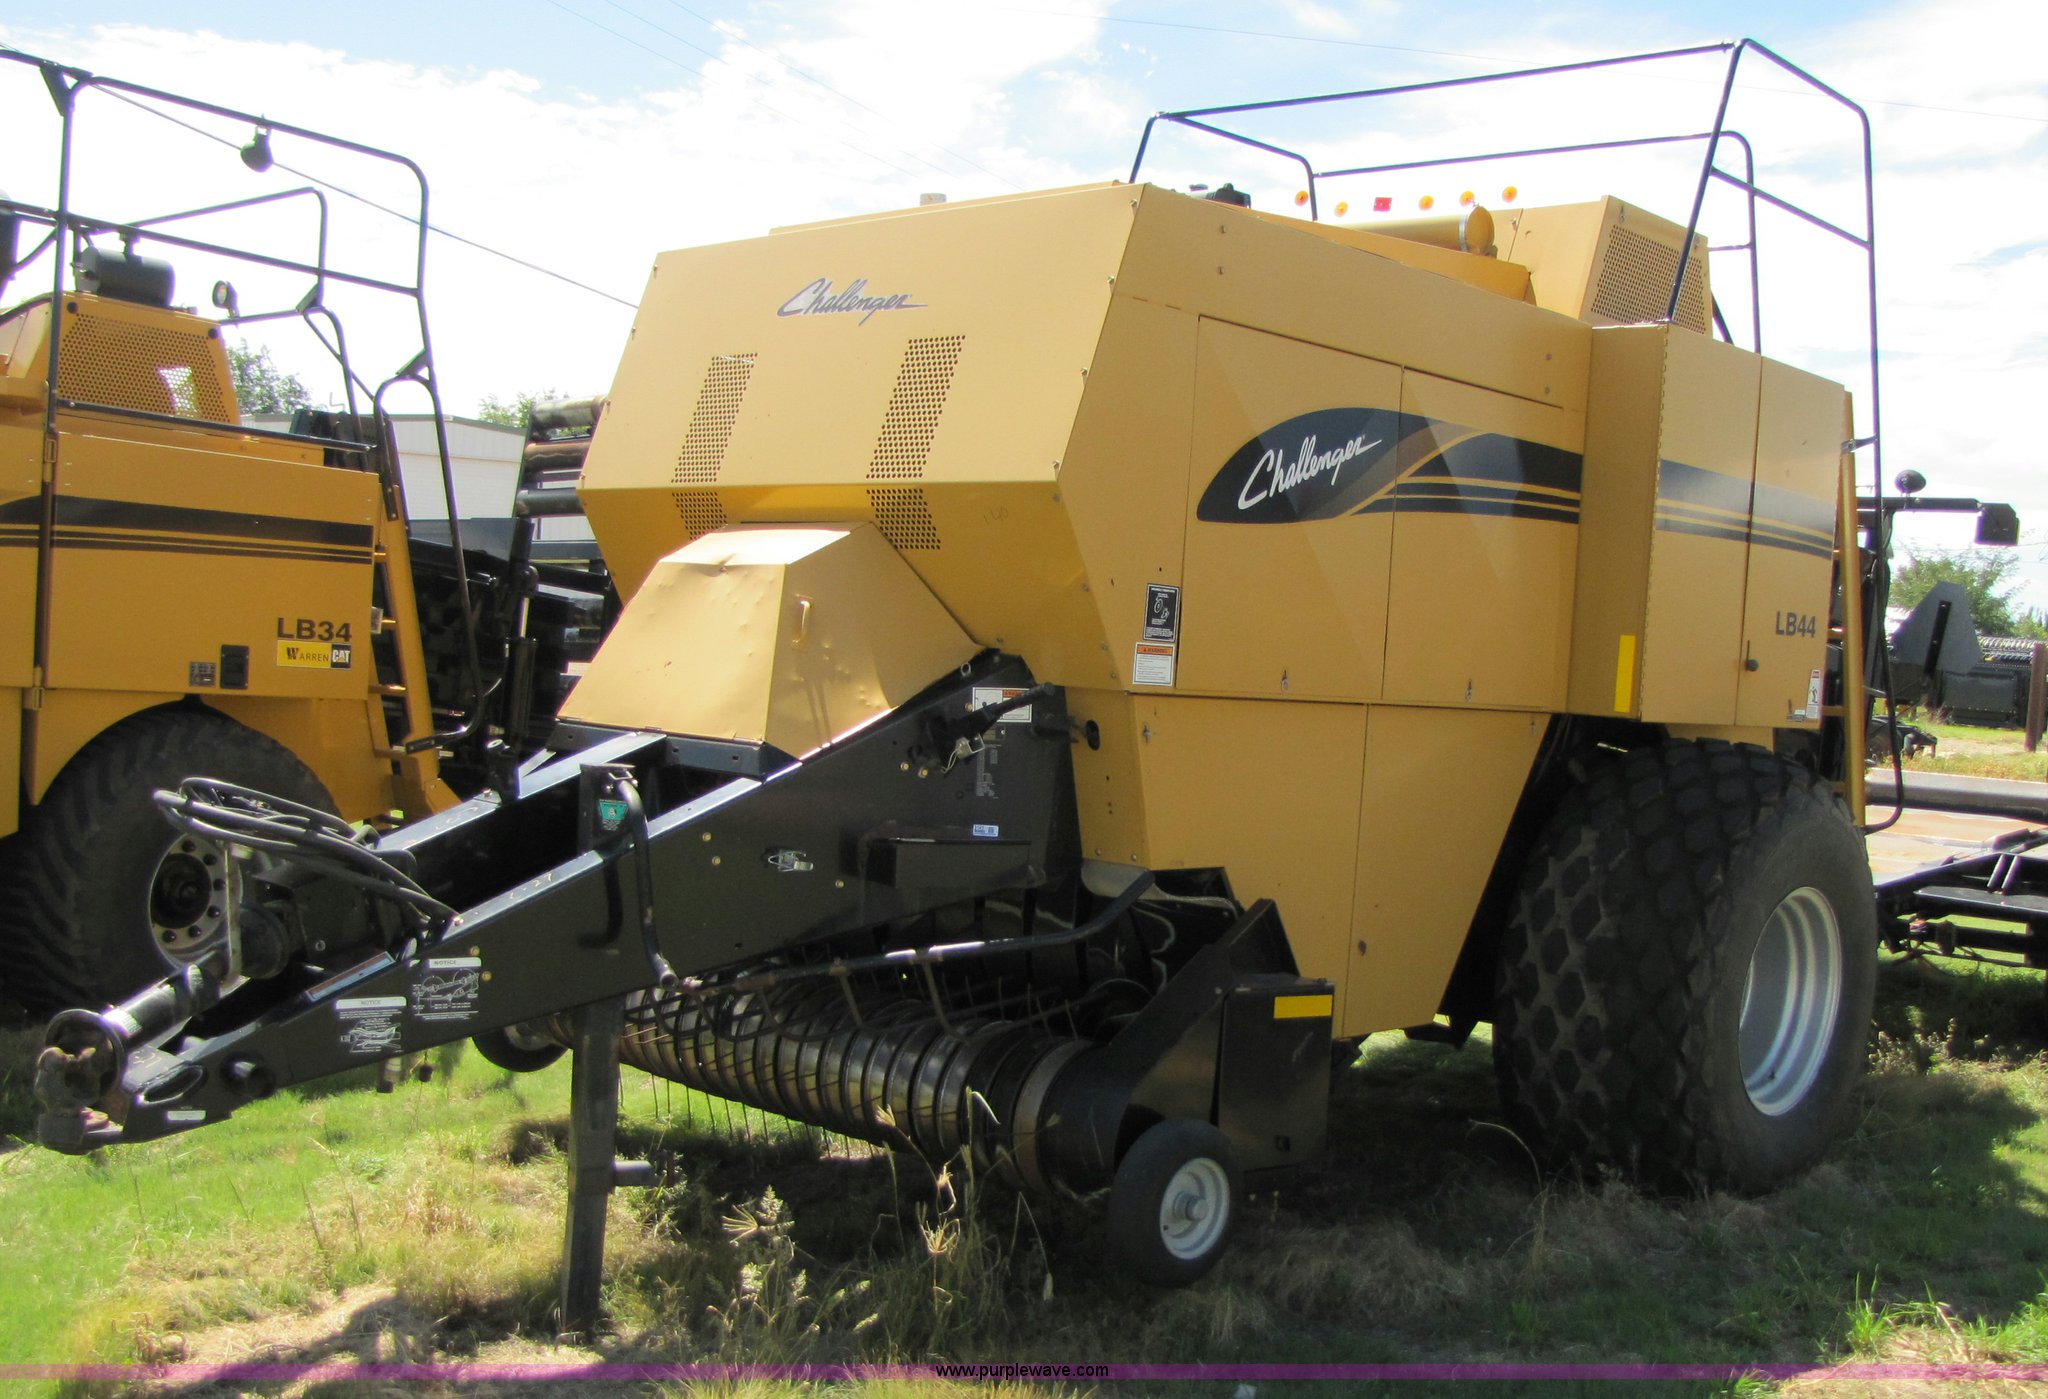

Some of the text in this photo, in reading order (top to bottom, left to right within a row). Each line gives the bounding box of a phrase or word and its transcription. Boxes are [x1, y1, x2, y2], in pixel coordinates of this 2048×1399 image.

[777, 278, 928, 326] Challenger
[1238, 434, 1383, 510] Challenger
[277, 617, 352, 641] LB34
[1775, 610, 1816, 638] LB44
[286, 647, 351, 664] WARREN CAT
